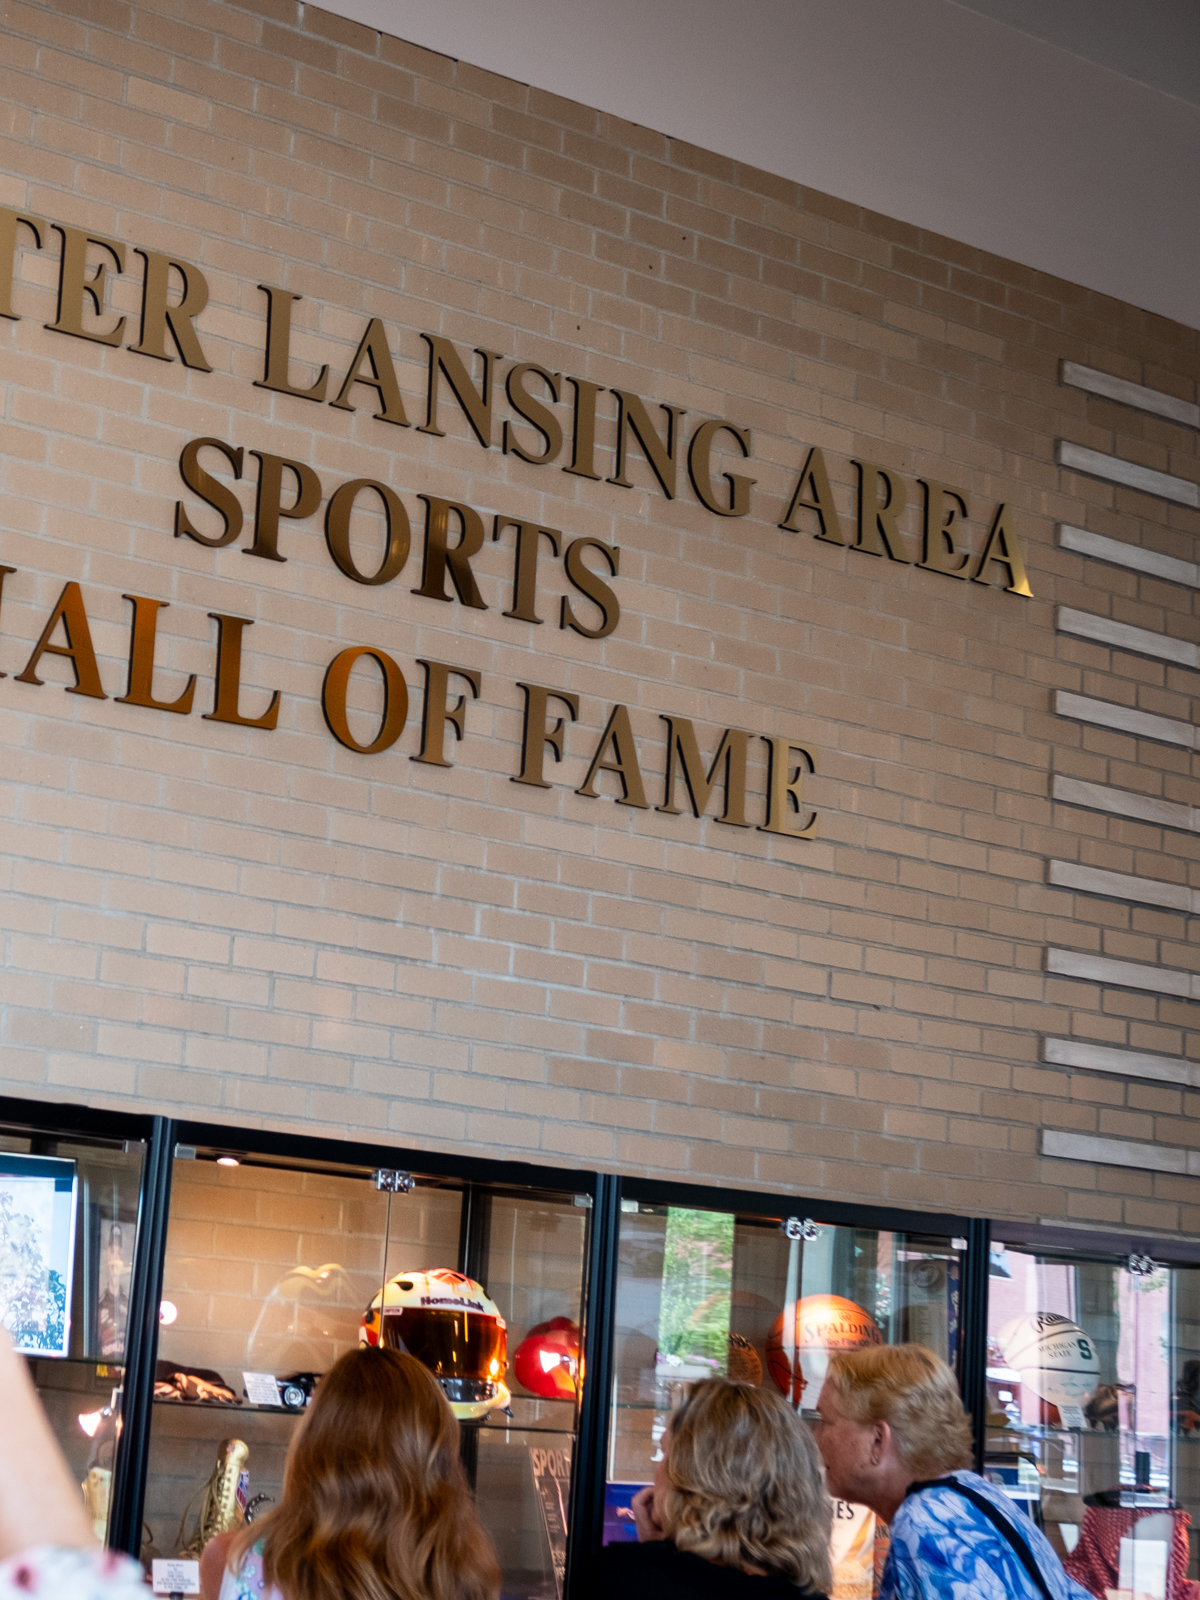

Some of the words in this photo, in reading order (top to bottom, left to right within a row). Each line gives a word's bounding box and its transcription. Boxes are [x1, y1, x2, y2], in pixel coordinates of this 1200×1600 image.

[253, 284, 757, 517] LANSING
[778, 447, 1034, 598] AREA
[174, 437, 620, 640] SPORTS
[321, 645, 481, 767] OF
[510, 681, 818, 840] FAME
[420, 1296, 484, 1312] HomeLink
[804, 1322, 881, 1345] SPALDING
[1038, 1341, 1077, 1352] MICHIGAN
[1076, 1338, 1093, 1360] S
